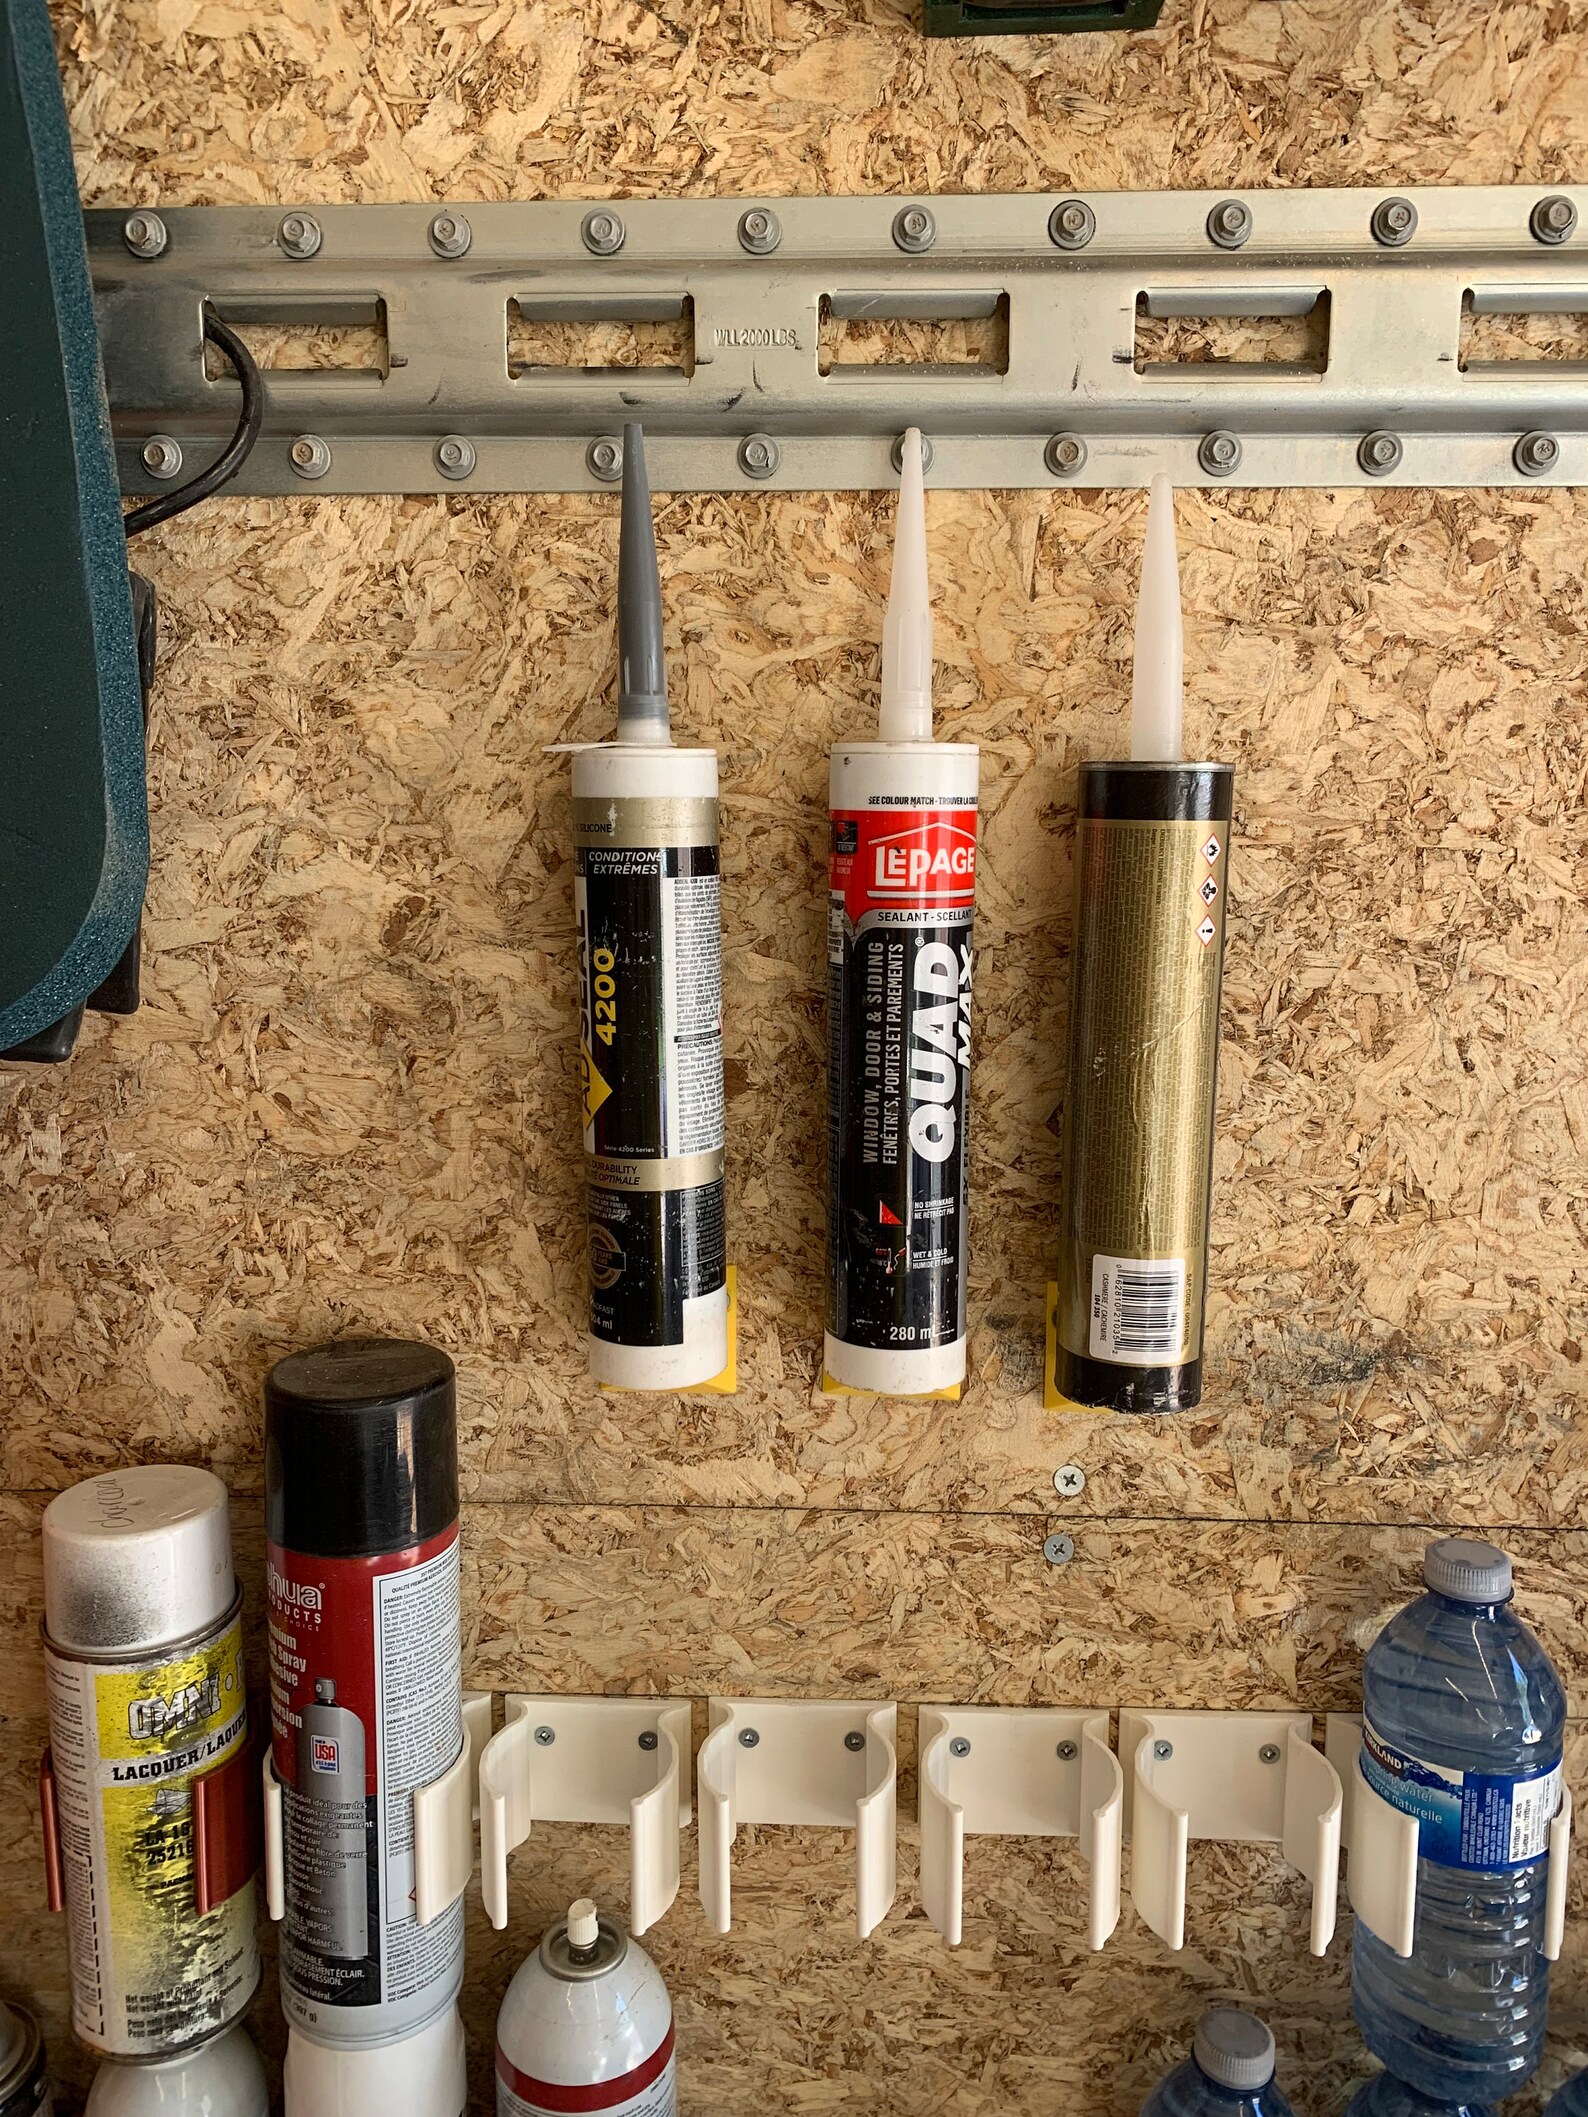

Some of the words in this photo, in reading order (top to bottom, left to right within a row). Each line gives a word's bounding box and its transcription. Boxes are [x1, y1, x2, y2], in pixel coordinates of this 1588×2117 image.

[868, 796, 880, 805] SEE
[881, 796, 909, 805] COLOUR
[910, 796, 935, 805] MATCH
[939, 796, 963, 805] TROUVER
[588, 851, 663, 863] CONDITIONS
[593, 862, 659, 875] EXTRÊMES
[877, 911, 929, 922] SEALANT
[936, 909, 972, 922] SCELLANT
[867, 942, 884, 1003] SIDING
[887, 943, 904, 1023] PAREMENTS
[593, 947, 617, 1046] 4200
[957, 943, 973, 1071] MAX
[866, 1012, 882, 1023] &
[886, 1024, 901, 1041] ET
[864, 1030, 882, 1077] DOOR
[908, 941, 959, 1162] QUAD
[884, 1044, 901, 1094] PORTES
[862, 1083, 882, 1163] WINDOW,
[880, 1096, 901, 1165] FENÊTRES,
[591, 1160, 638, 1175] DURABILITY
[598, 1173, 641, 1186] OPTIMALE
[914, 1201, 924, 1209] NO
[933, 1247, 948, 1256] COLD
[1101, 1273, 1109, 1304] CASHMERE
[1114, 1279, 1122, 1308] 62810
[889, 1326, 916, 1341] 280
[1113, 1312, 1121, 1340] 21035
[278, 1645, 307, 1673] Spray
[315, 1744, 336, 1762] USA
[331, 1802, 351, 1811] pour
[352, 1800, 367, 1809] des
[1392, 1795, 1443, 1824] naturelle
[302, 1816, 327, 1828] collage
[328, 1821, 373, 1830] permanent
[1523, 1799, 1531, 1831] nutritive
[1512, 1826, 1521, 1859] Nutrition
[1520, 1834, 1529, 1857] Valeur
[316, 1848, 332, 1857] fibre
[334, 1850, 344, 1859] de
[344, 1851, 368, 1859] verre
[312, 1858, 346, 1869] plastique
[306, 1918, 333, 1933] VAPORS
[308, 1971, 343, 1986] PRESSION.
[336, 1969, 365, 1978] ÉCLAIR.
[309, 1987, 332, 2001] latéral.
